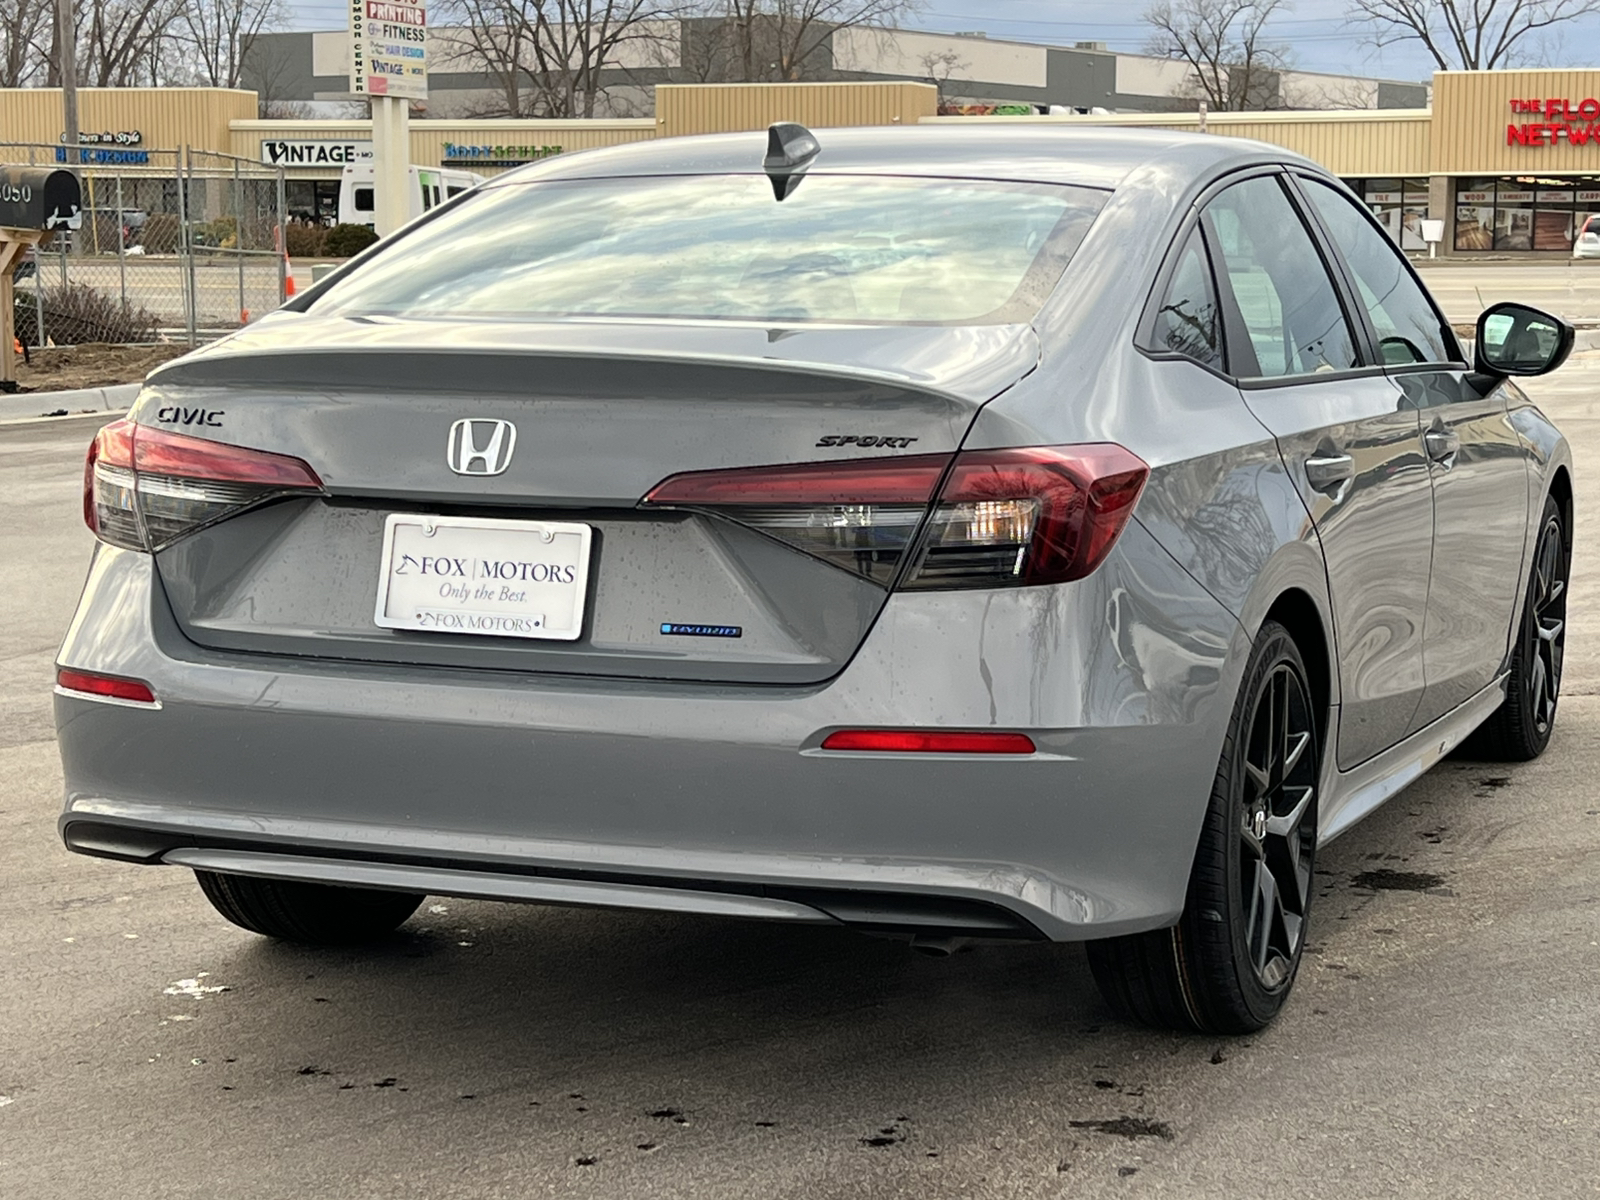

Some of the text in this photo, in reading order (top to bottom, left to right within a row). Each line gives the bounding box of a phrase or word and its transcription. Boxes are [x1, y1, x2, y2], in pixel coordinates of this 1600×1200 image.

[370, 3, 422, 25] PRINTING
[383, 24, 425, 42] FITNESS
[354, 44, 363, 91] CENTER
[371, 59, 404, 75] VINTAGE
[1509, 99, 1541, 113] THE
[115, 130, 141, 146] Style
[265, 142, 355, 163] VINTAGE
[1464, 193, 1486, 201] WOOD
[158, 407, 225, 427] CIVIC
[815, 435, 919, 449] SPORT
[420, 556, 576, 584] FOX MOTORS
[439, 582, 528, 604] Only the Best.
[434, 613, 532, 633] FOX MOTORS
